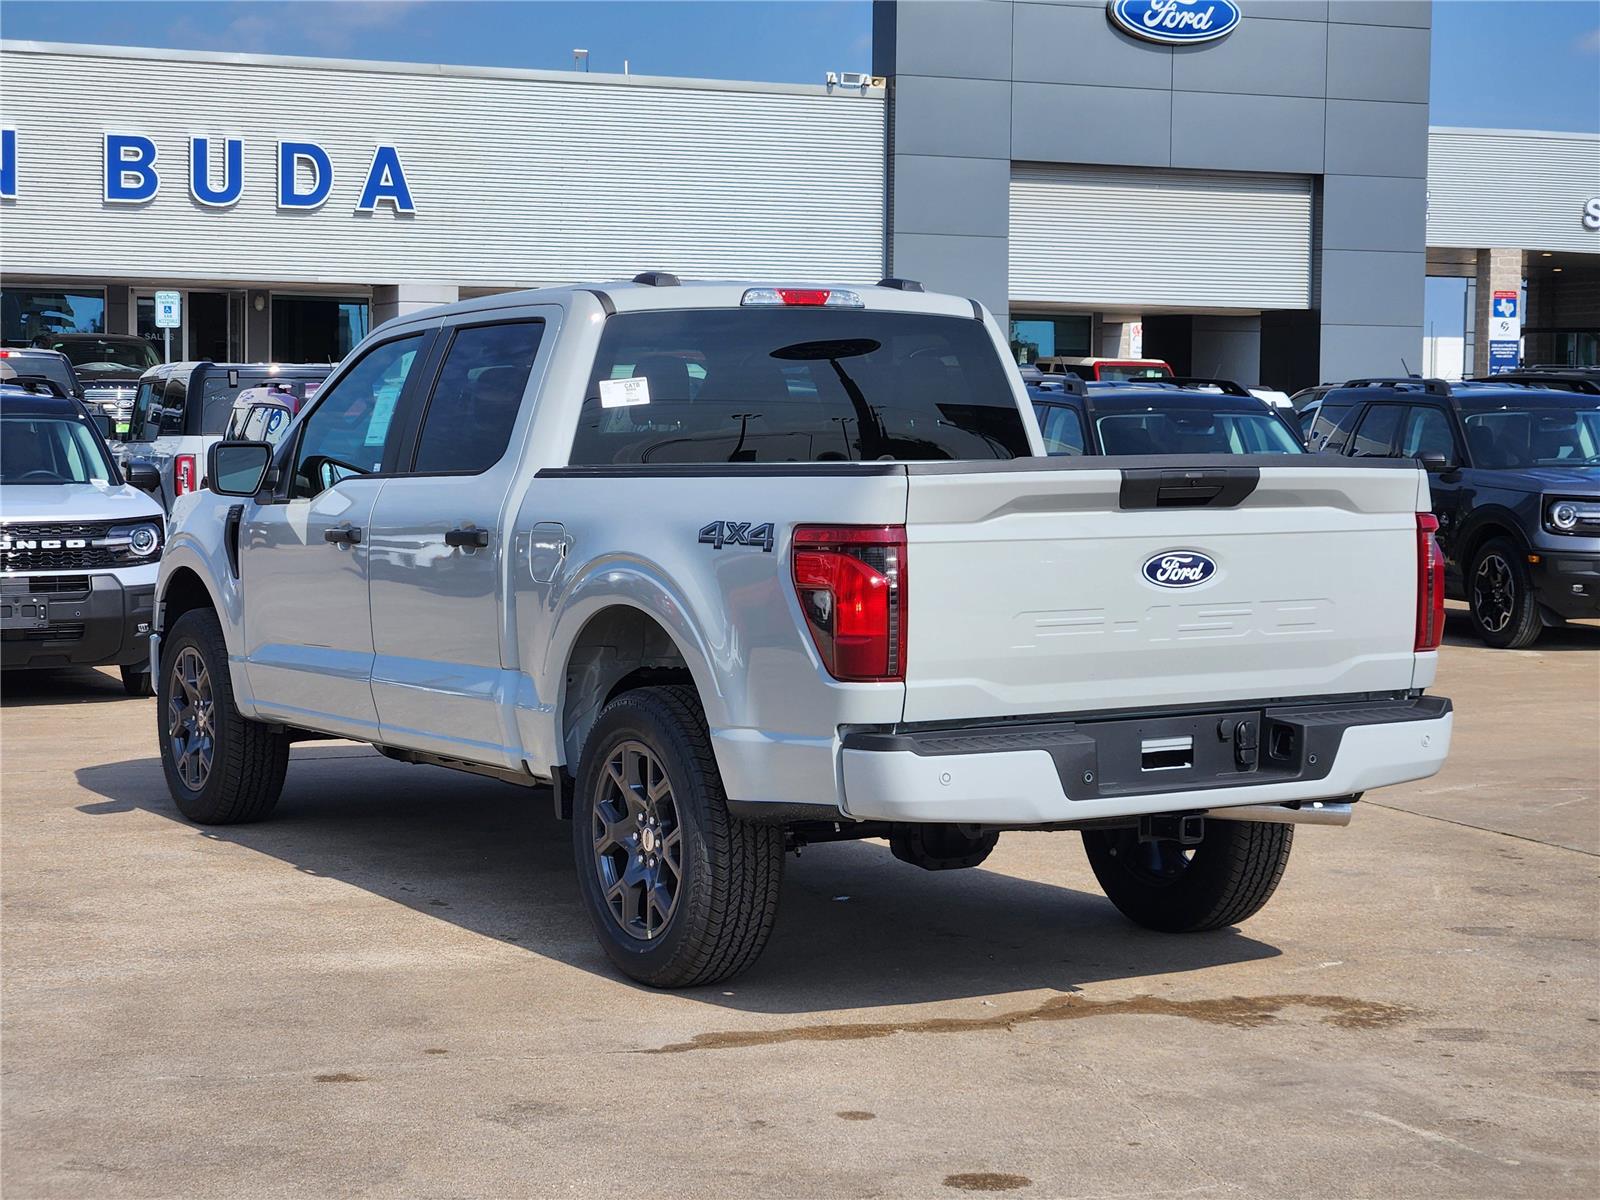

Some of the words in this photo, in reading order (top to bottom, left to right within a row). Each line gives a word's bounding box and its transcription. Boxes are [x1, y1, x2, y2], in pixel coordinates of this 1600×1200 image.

[1143, 0, 1215, 30] Ford
[103, 130, 417, 214] BUDA
[1156, 556, 1205, 582] Ford
